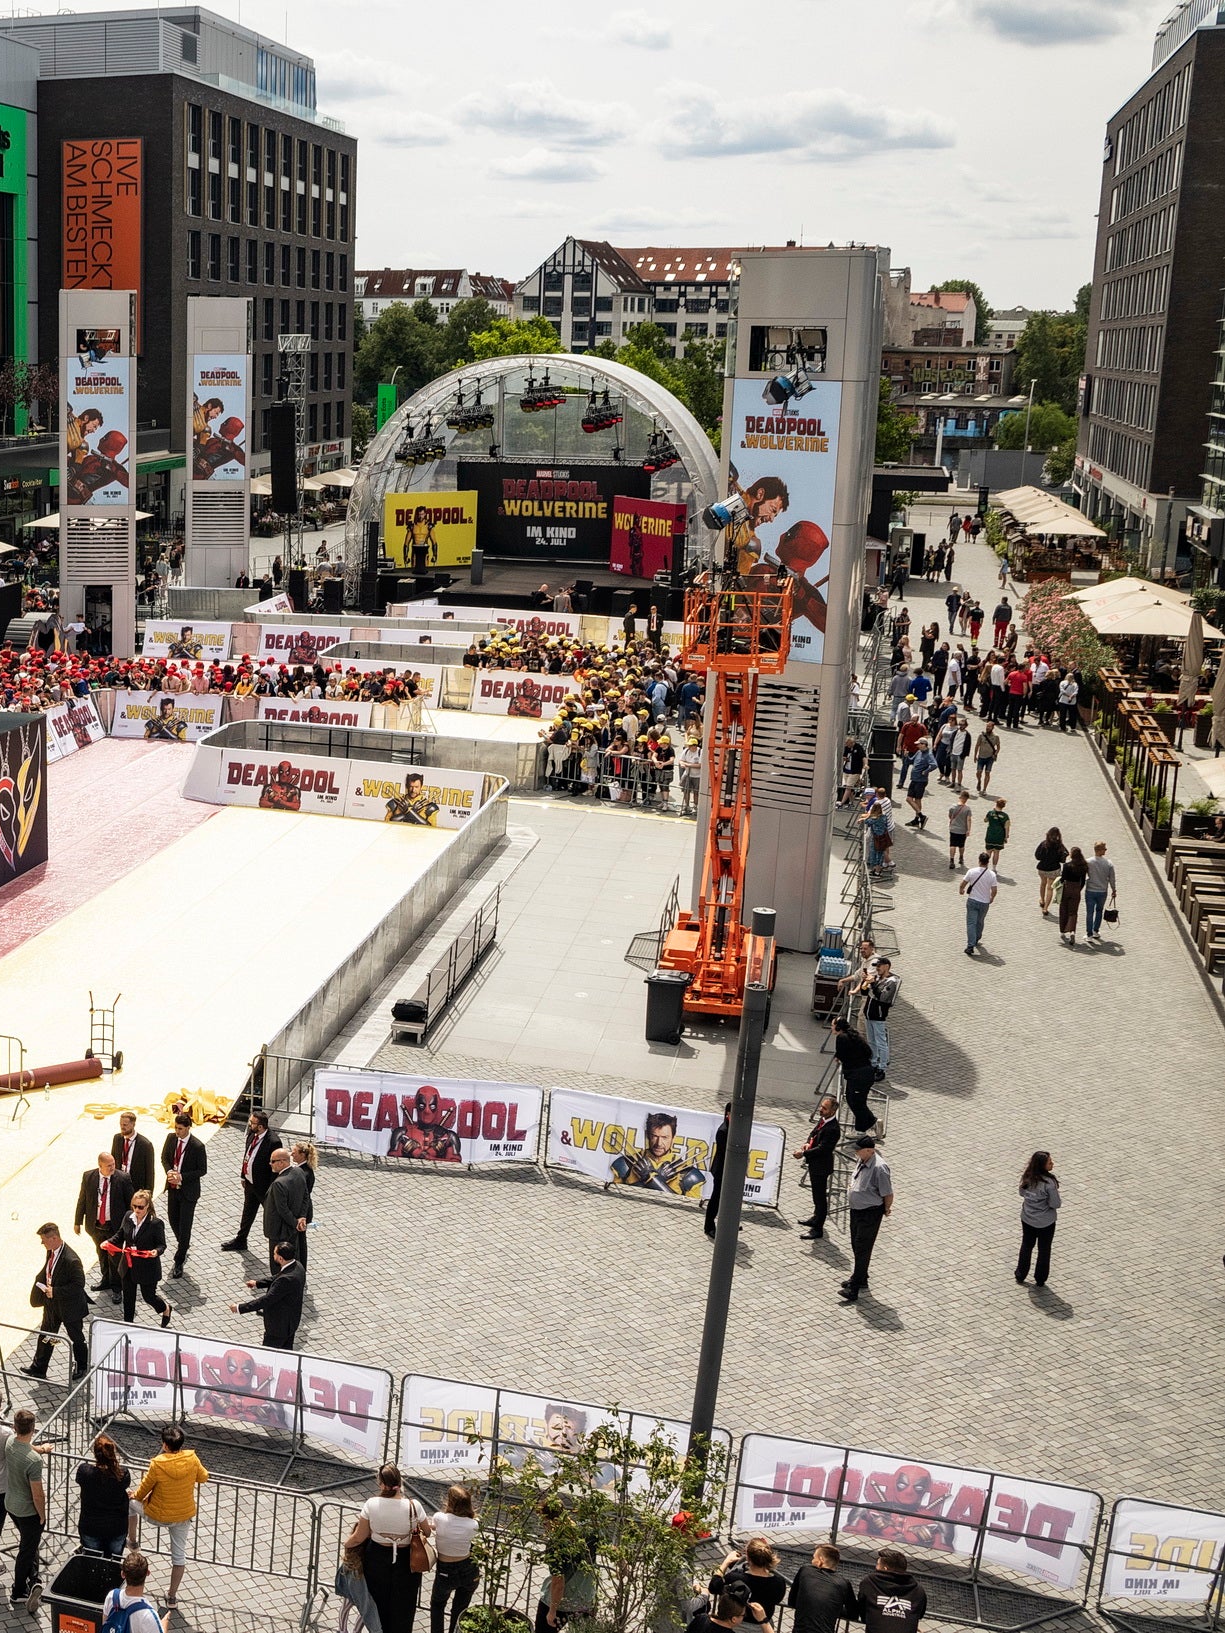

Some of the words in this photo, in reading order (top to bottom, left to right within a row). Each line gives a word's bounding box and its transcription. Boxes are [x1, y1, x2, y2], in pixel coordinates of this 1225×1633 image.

[66, 143, 88, 187] AM
[116, 141, 138, 196] LIVE
[66, 195, 88, 290] BESTEN
[75, 376, 122, 386] DEADPOOL
[200, 371, 240, 379] DEADPOOL
[745, 415, 826, 437] DEADPOOL
[502, 479, 603, 501] DEADPOOL
[526, 526, 542, 538] IM
[546, 526, 576, 539] KINO
[614, 512, 673, 537] WOLERINE
[536, 537, 548, 546] 24.
[550, 538, 566, 546] JULI
[792, 634, 811, 644] KINO
[120, 704, 216, 725] &WOLERINE
[355, 779, 474, 808] &WOLERINE
[489, 1143, 501, 1151] IM
[502, 1144, 523, 1152] KINO
[744, 1184, 761, 1193] INO
